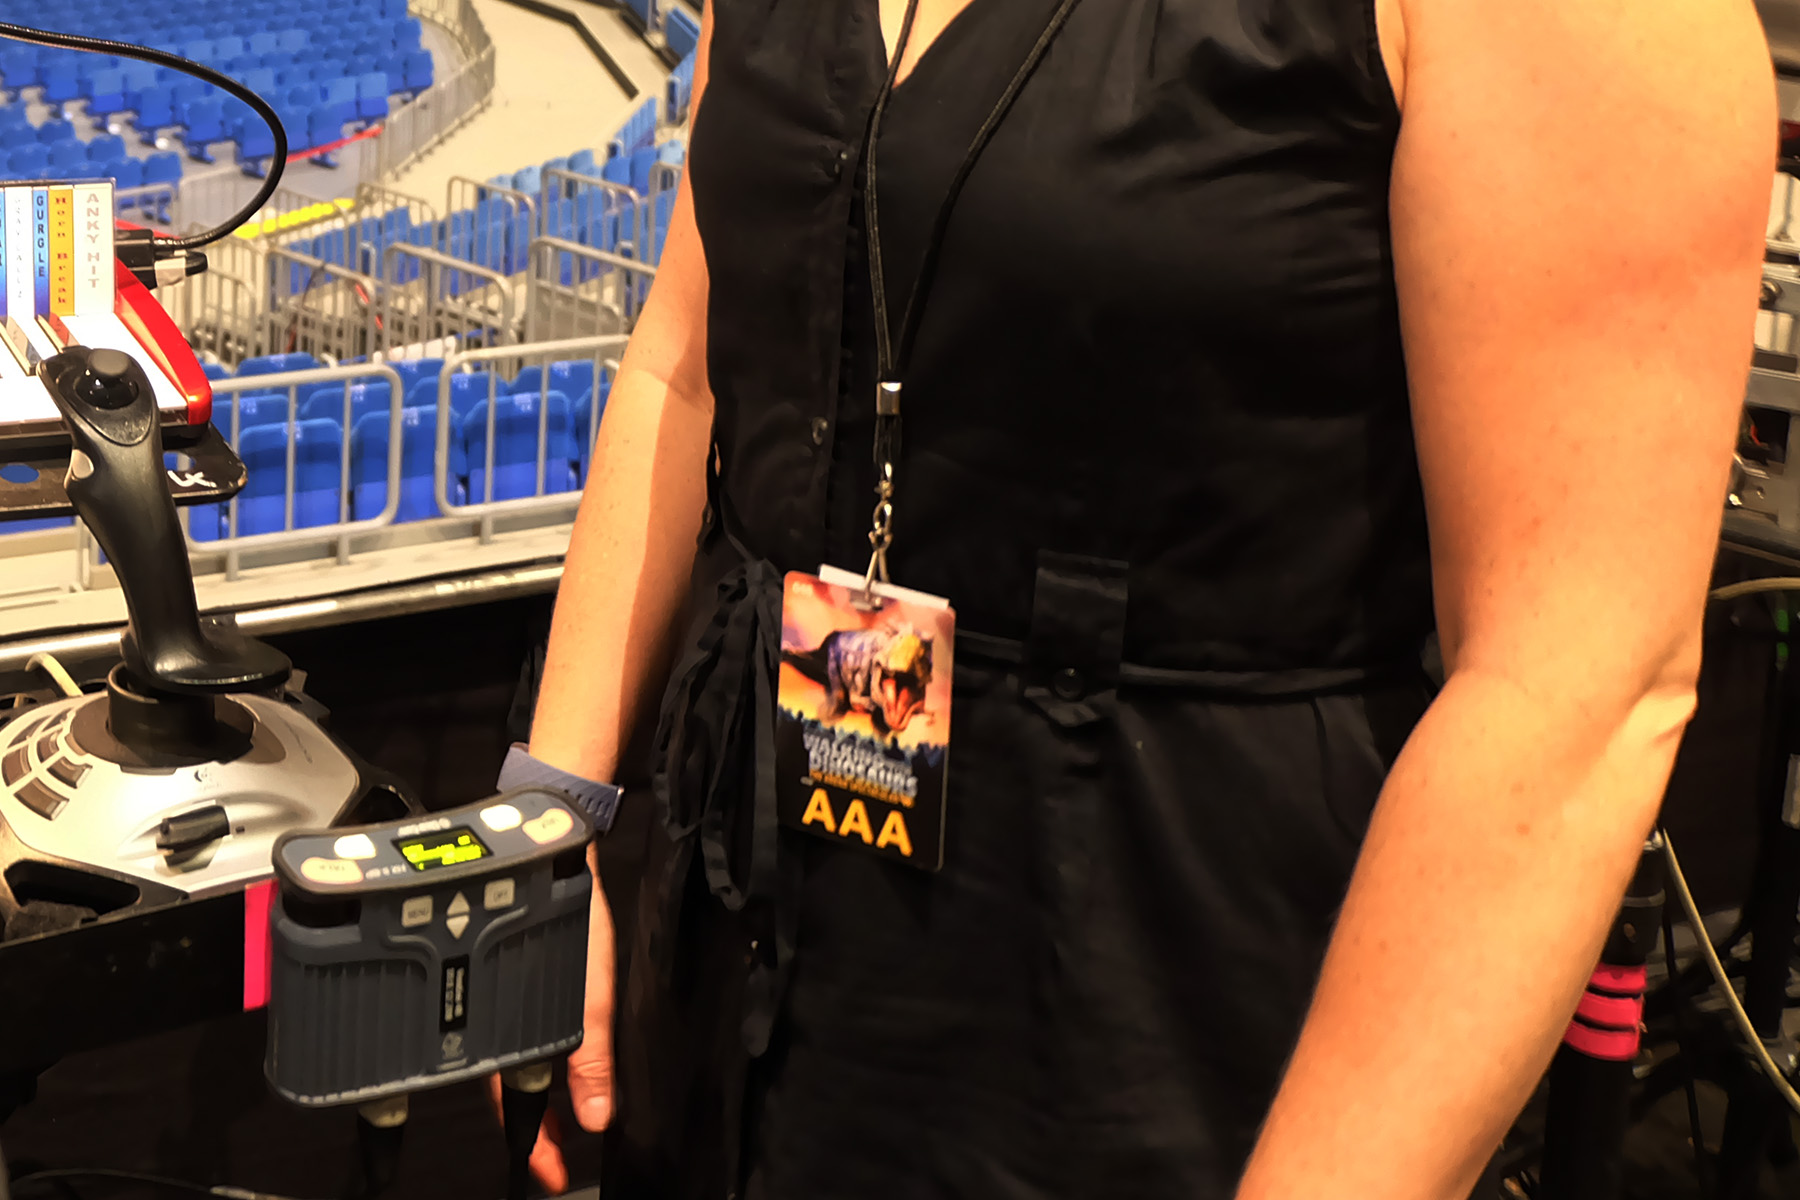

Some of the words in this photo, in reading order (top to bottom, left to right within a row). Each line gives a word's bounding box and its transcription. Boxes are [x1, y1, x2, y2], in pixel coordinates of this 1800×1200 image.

[36, 195, 45, 278] GURGLE
[86, 193, 100, 244] ANKY
[87, 252, 100, 288] HIT
[801, 787, 914, 858] AAA
